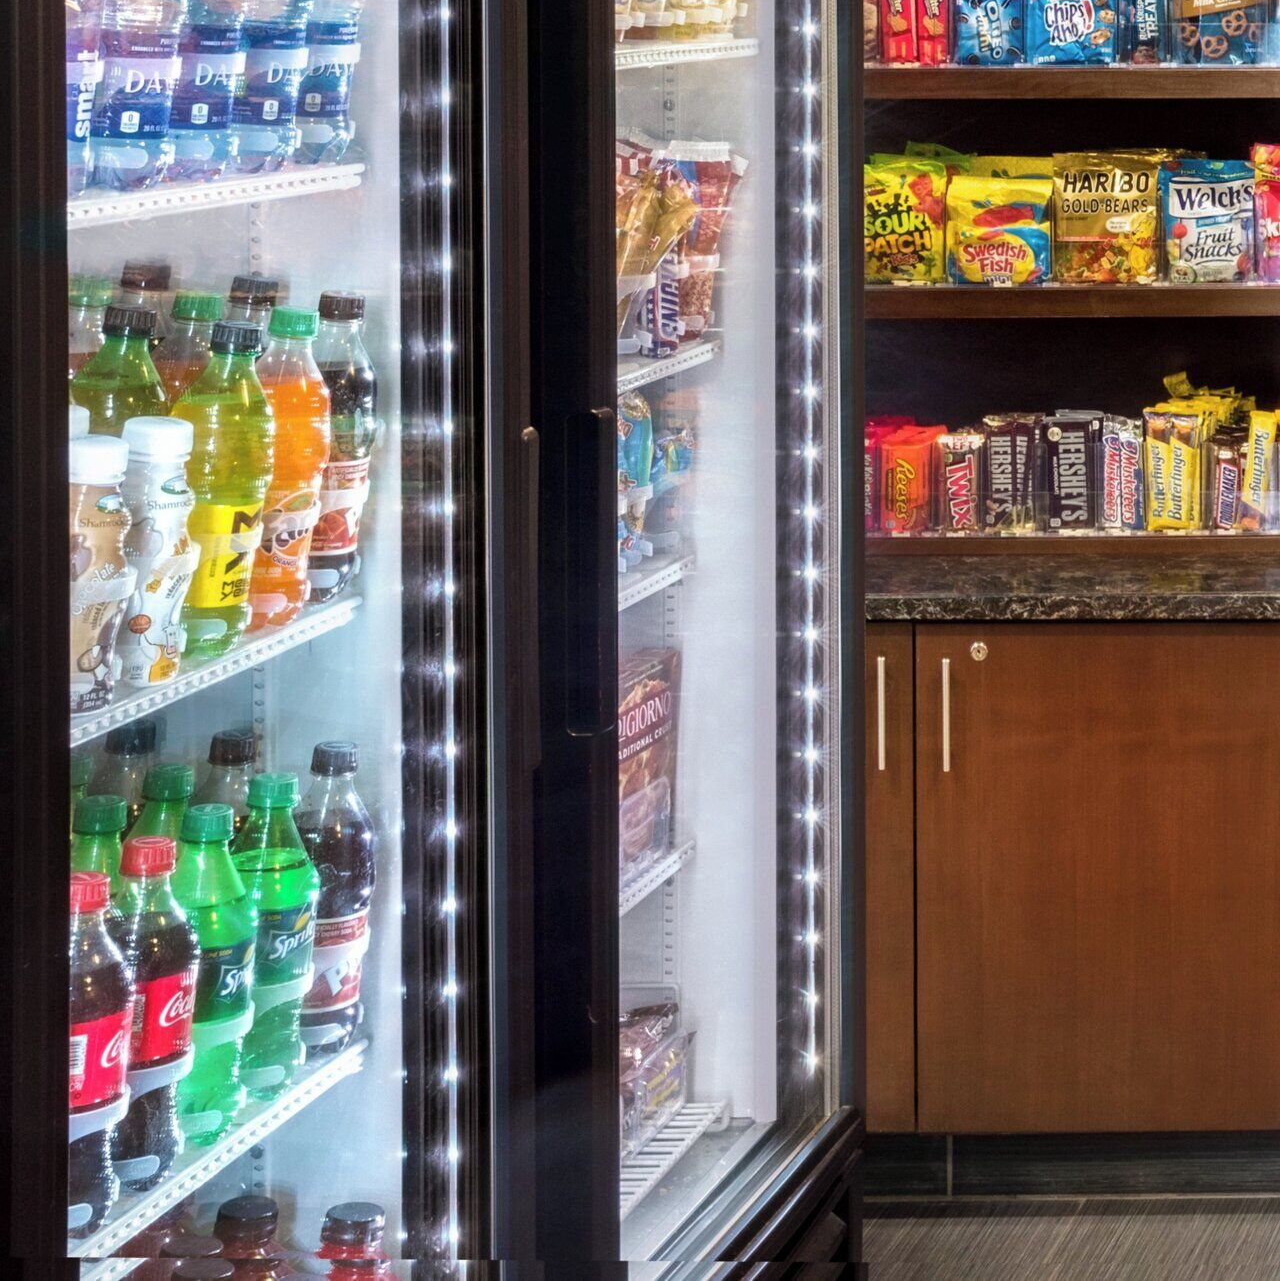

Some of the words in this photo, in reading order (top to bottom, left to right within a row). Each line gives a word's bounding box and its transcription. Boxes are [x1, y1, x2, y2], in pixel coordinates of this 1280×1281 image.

[1045, 3, 1084, 28] Chips
[985, 0, 1003, 59] OREO
[75, 49, 99, 138] smart
[1062, 170, 1150, 195] HARIBO
[1174, 182, 1254, 211] Welch's
[864, 212, 927, 236] SOUR
[1195, 229, 1235, 247] Fruit
[962, 242, 1028, 265] Swedish
[1184, 242, 1243, 262] Snacks
[977, 257, 1014, 275] Fish
[1058, 431, 1088, 522] HERSHEY'S
[1250, 427, 1270, 505] Butterfinger
[1167, 443, 1187, 521] Butterfinger
[1219, 465, 1238, 528] TROUBLEMAKER
[619, 734, 653, 759] ADITIONAL
